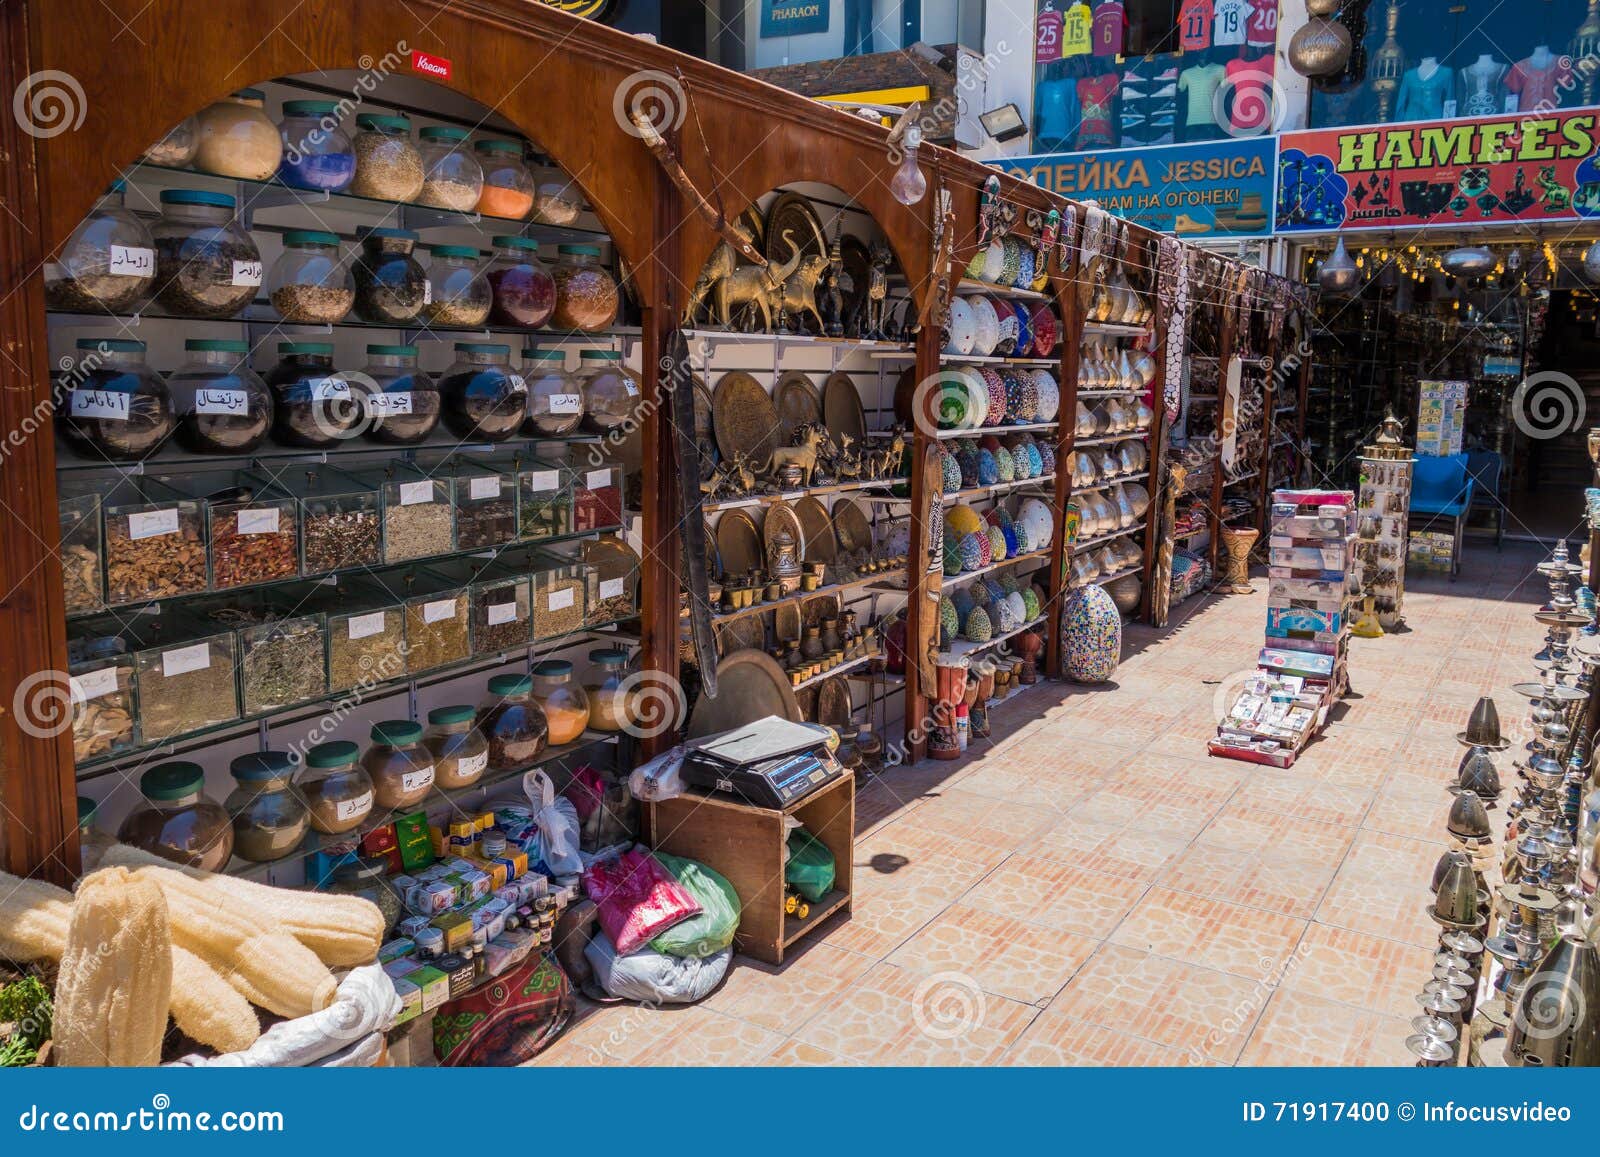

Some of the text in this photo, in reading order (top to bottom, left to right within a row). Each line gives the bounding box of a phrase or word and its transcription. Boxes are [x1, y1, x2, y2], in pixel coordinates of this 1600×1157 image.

[1070, 18, 1084, 40] 15
[1185, 16, 1203, 38] 11
[1223, 11, 1239, 33] 19
[1254, 8, 1277, 30] 20
[1038, 25, 1057, 45] 25
[1103, 24, 1112, 44] 6
[417, 56, 448, 75] Kream
[1337, 115, 1596, 173] HAMEES
[1161, 156, 1267, 183] JESSICA
[1138, 193, 1161, 209] НА
[1165, 188, 1240, 208] ОГОНЕК!
